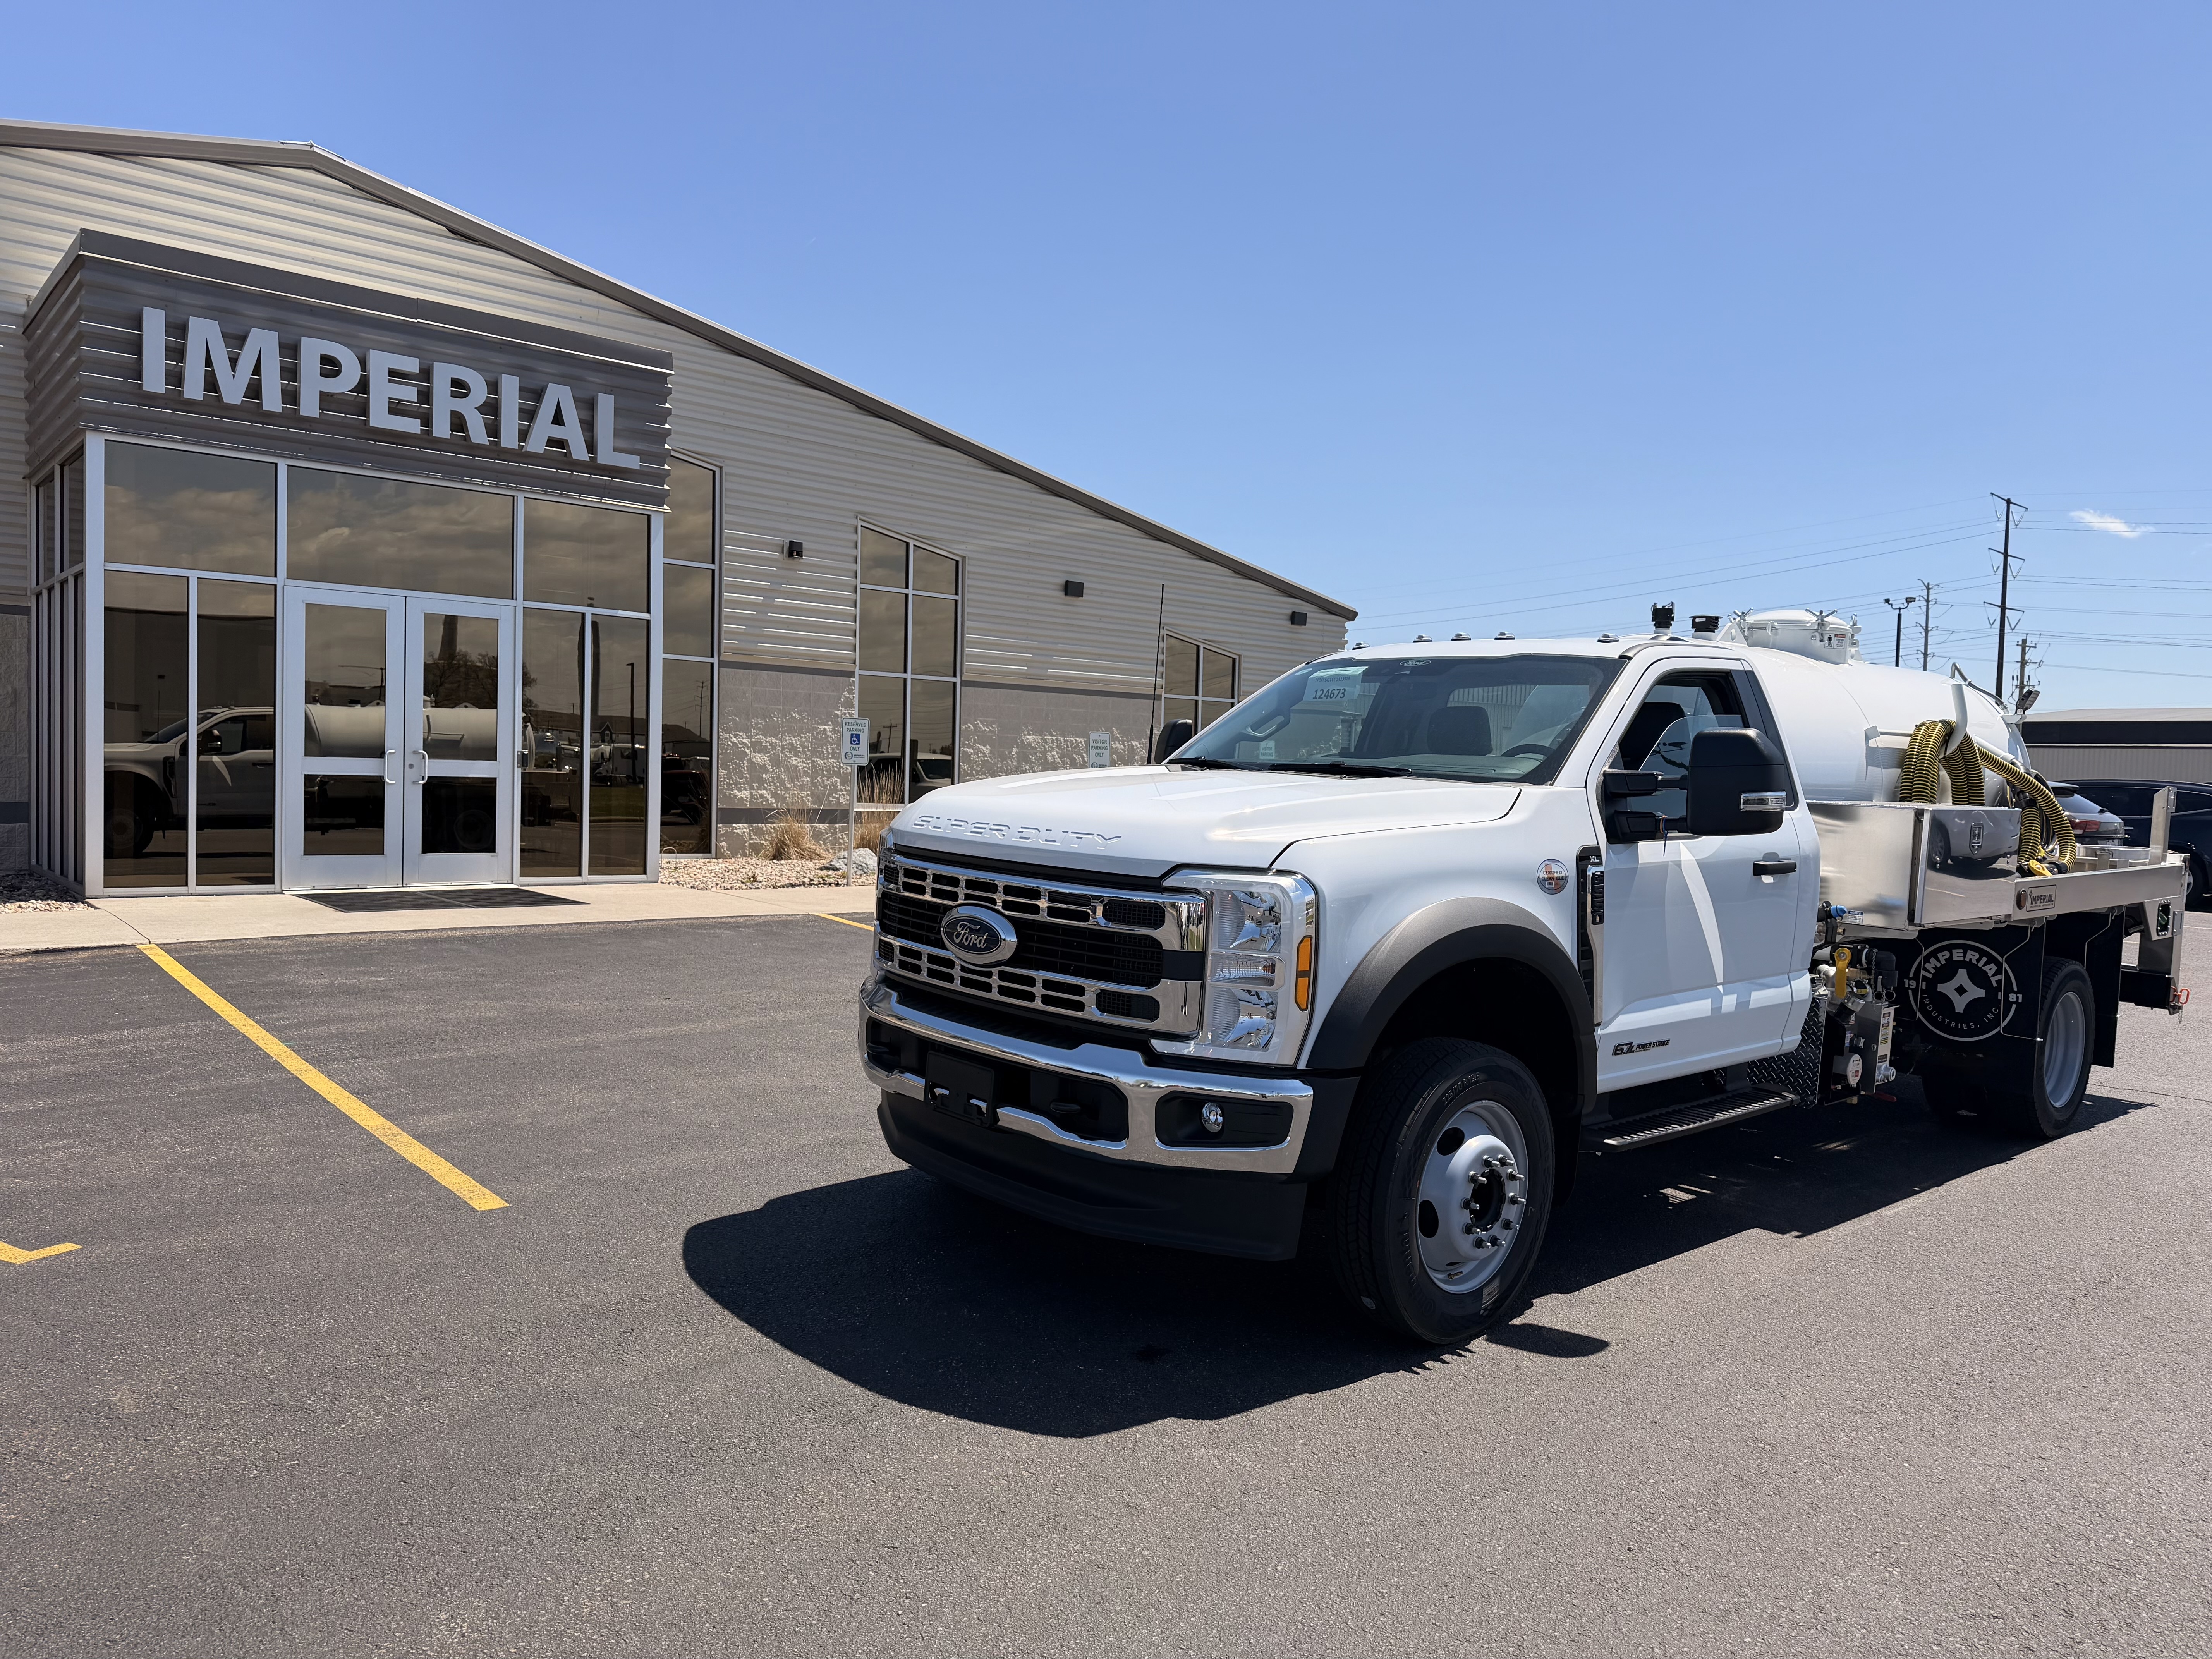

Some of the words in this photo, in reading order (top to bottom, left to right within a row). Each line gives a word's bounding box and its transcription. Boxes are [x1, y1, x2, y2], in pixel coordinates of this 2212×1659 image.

[139, 306, 640, 469] IMPERIAL
[1313, 688, 1346, 699] 124673
[912, 815, 1010, 839] SUPER
[1012, 826, 1122, 850] DUTY
[2030, 894, 2054, 905] IMPERIAL
[953, 921, 989, 948] Ford
[1921, 949, 2002, 987] IMPERIAL
[1904, 979, 1917, 988] 19
[2009, 993, 2023, 1003] 81
[1922, 994, 1980, 1029] INDUSTRIES,
[1984, 1005, 2001, 1022] INC.
[1636, 1042, 1652, 1051] POWER
[1652, 1040, 1670, 1048] STROKE
